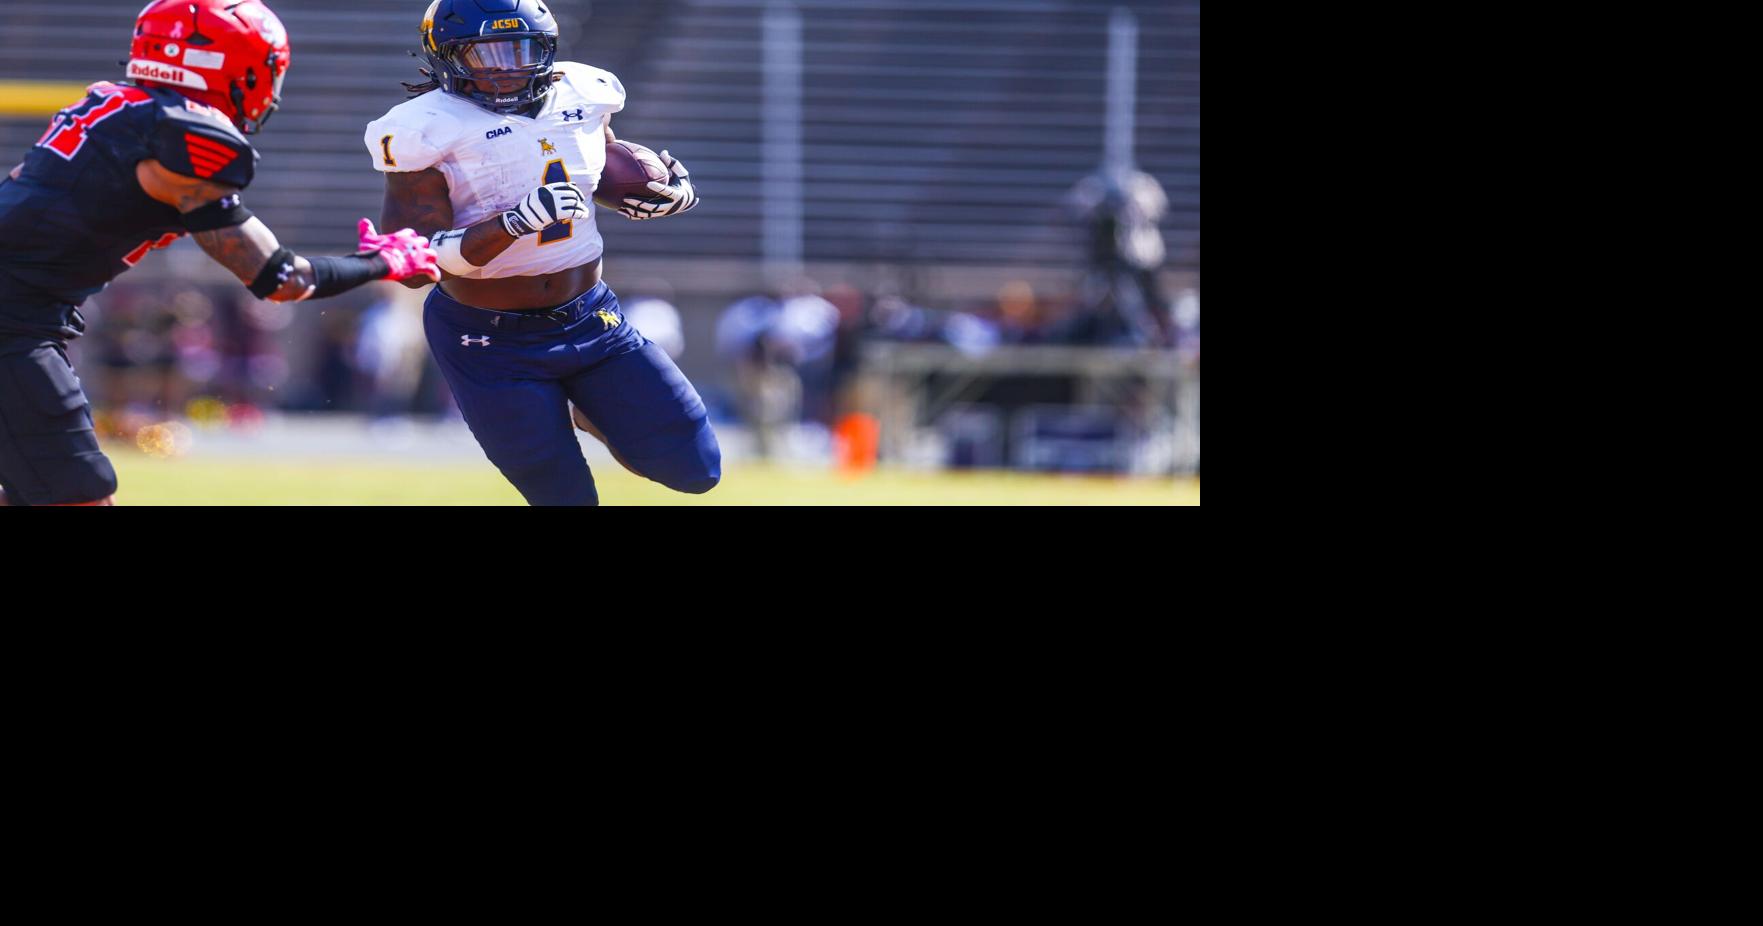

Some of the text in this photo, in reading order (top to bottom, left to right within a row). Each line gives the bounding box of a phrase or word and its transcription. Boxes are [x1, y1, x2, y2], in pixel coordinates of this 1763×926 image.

[492, 19, 519, 29] JCSU
[131, 63, 184, 82] Riddell
[486, 126, 512, 139] CIAA
[380, 134, 397, 167] 1
